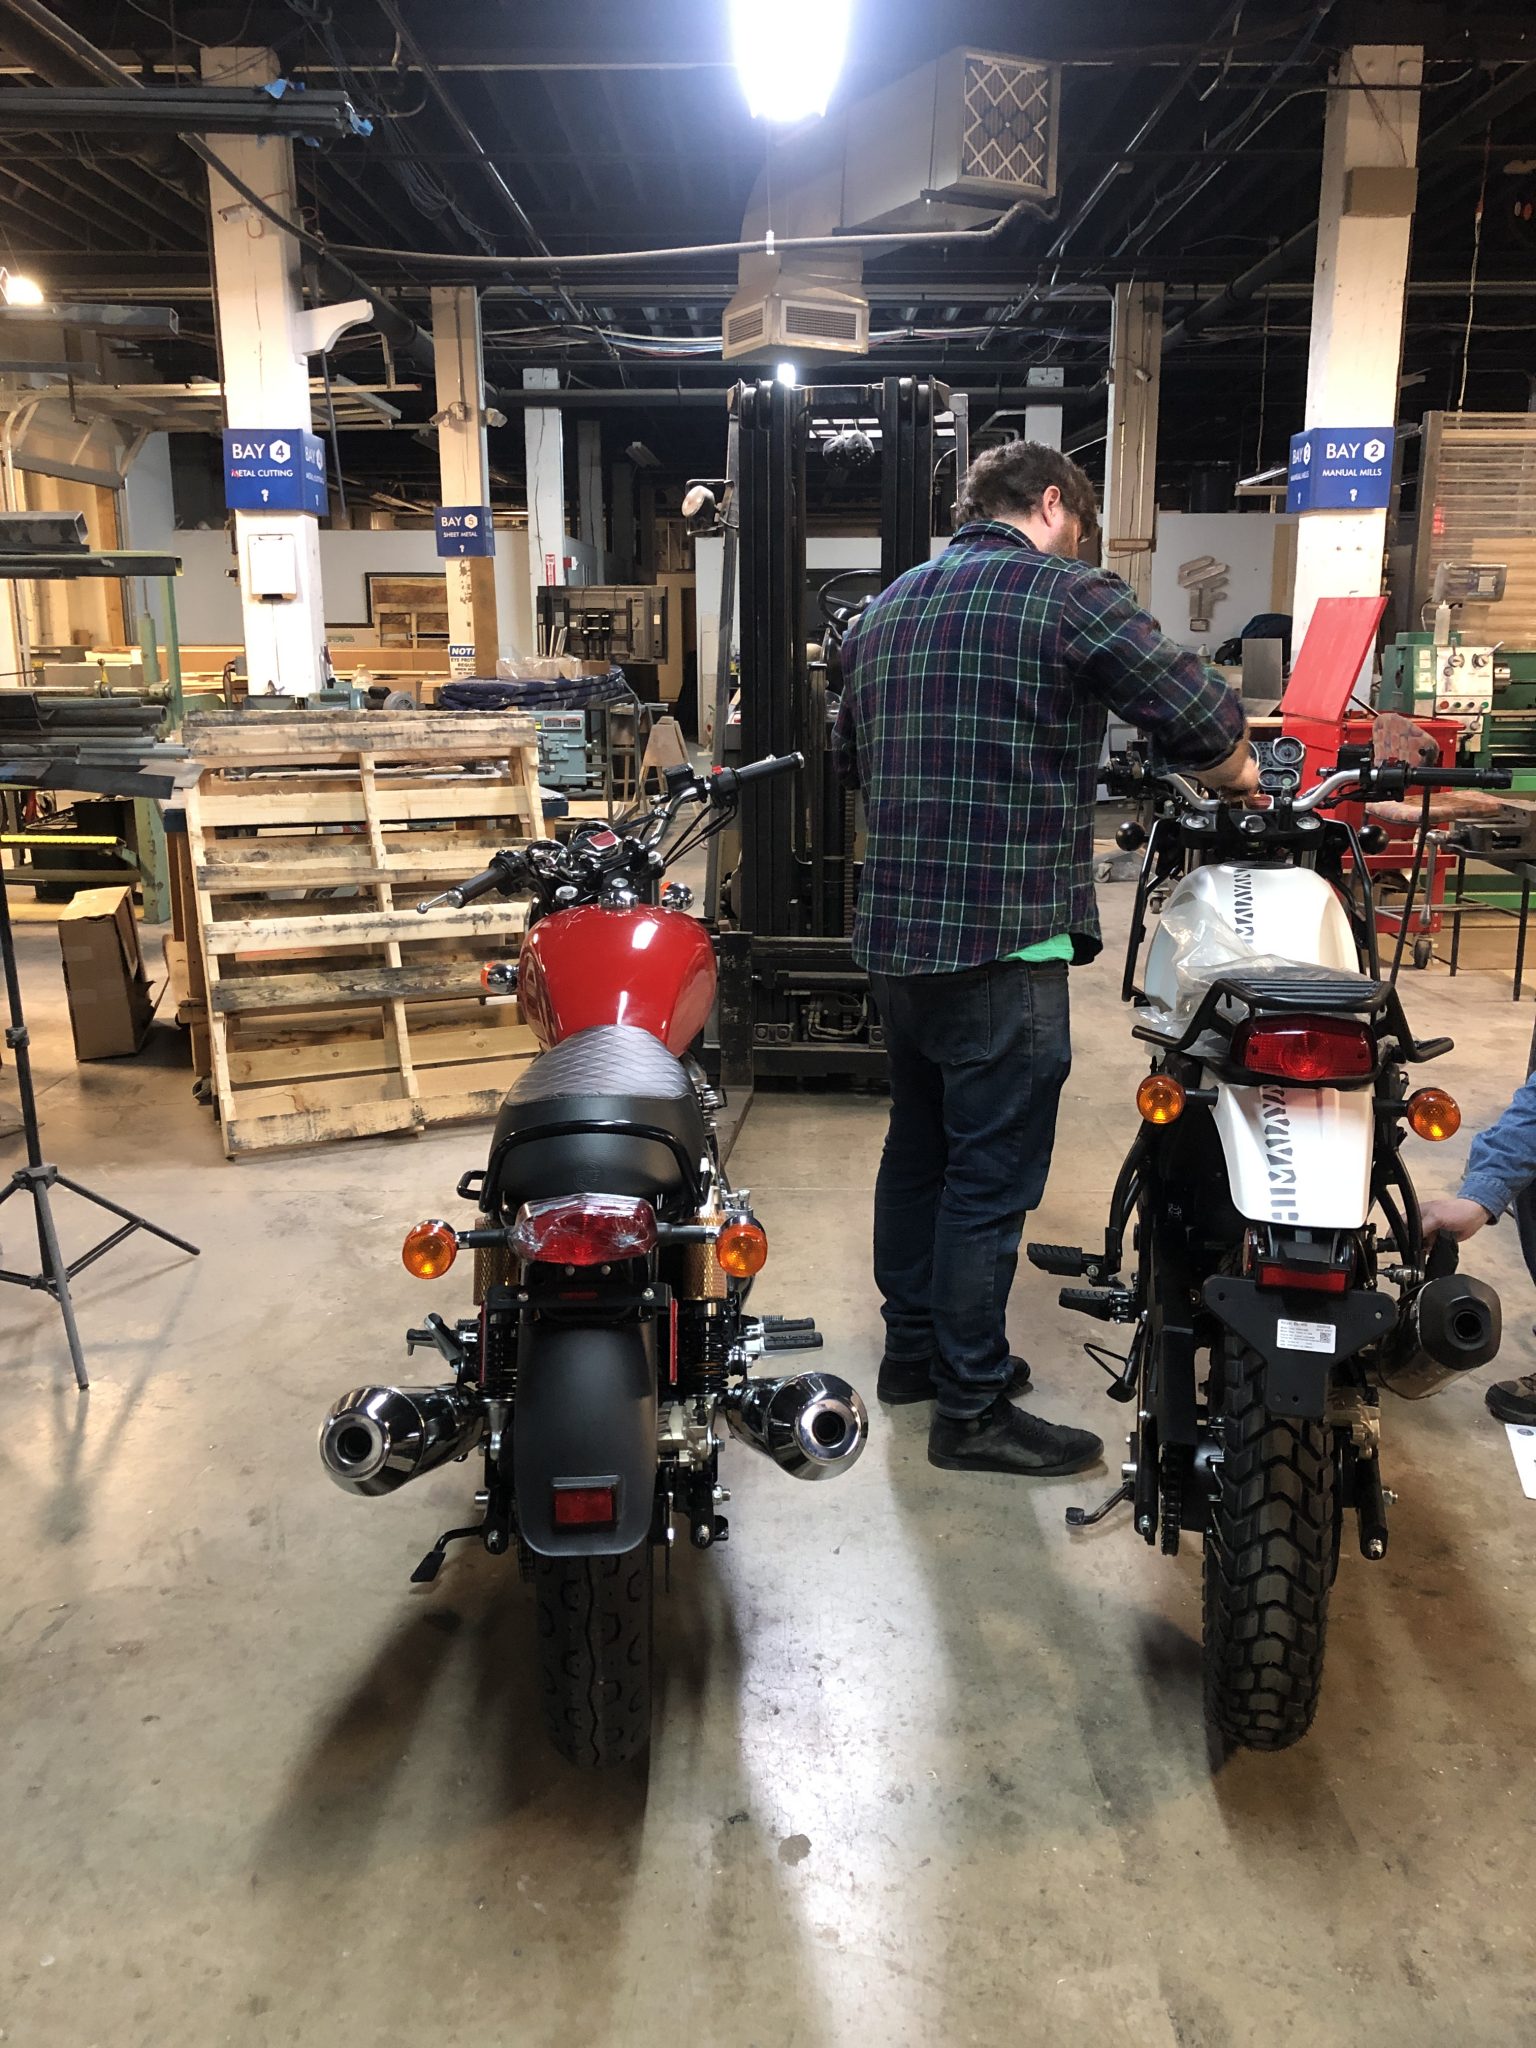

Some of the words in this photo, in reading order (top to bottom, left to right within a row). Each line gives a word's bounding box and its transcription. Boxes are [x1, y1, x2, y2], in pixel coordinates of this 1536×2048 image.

[232, 443, 265, 459] BAY
[1326, 442, 1361, 459] BAY
[231, 468, 256, 478] METAL
[257, 469, 294, 478] CUTTING
[1322, 469, 1358, 477] MANUAL
[1359, 468, 1382, 477] MILLS
[441, 516, 462, 527] BAY
[451, 647, 476, 656] NOTI
[1233, 868, 1255, 944] IMALAYAN
